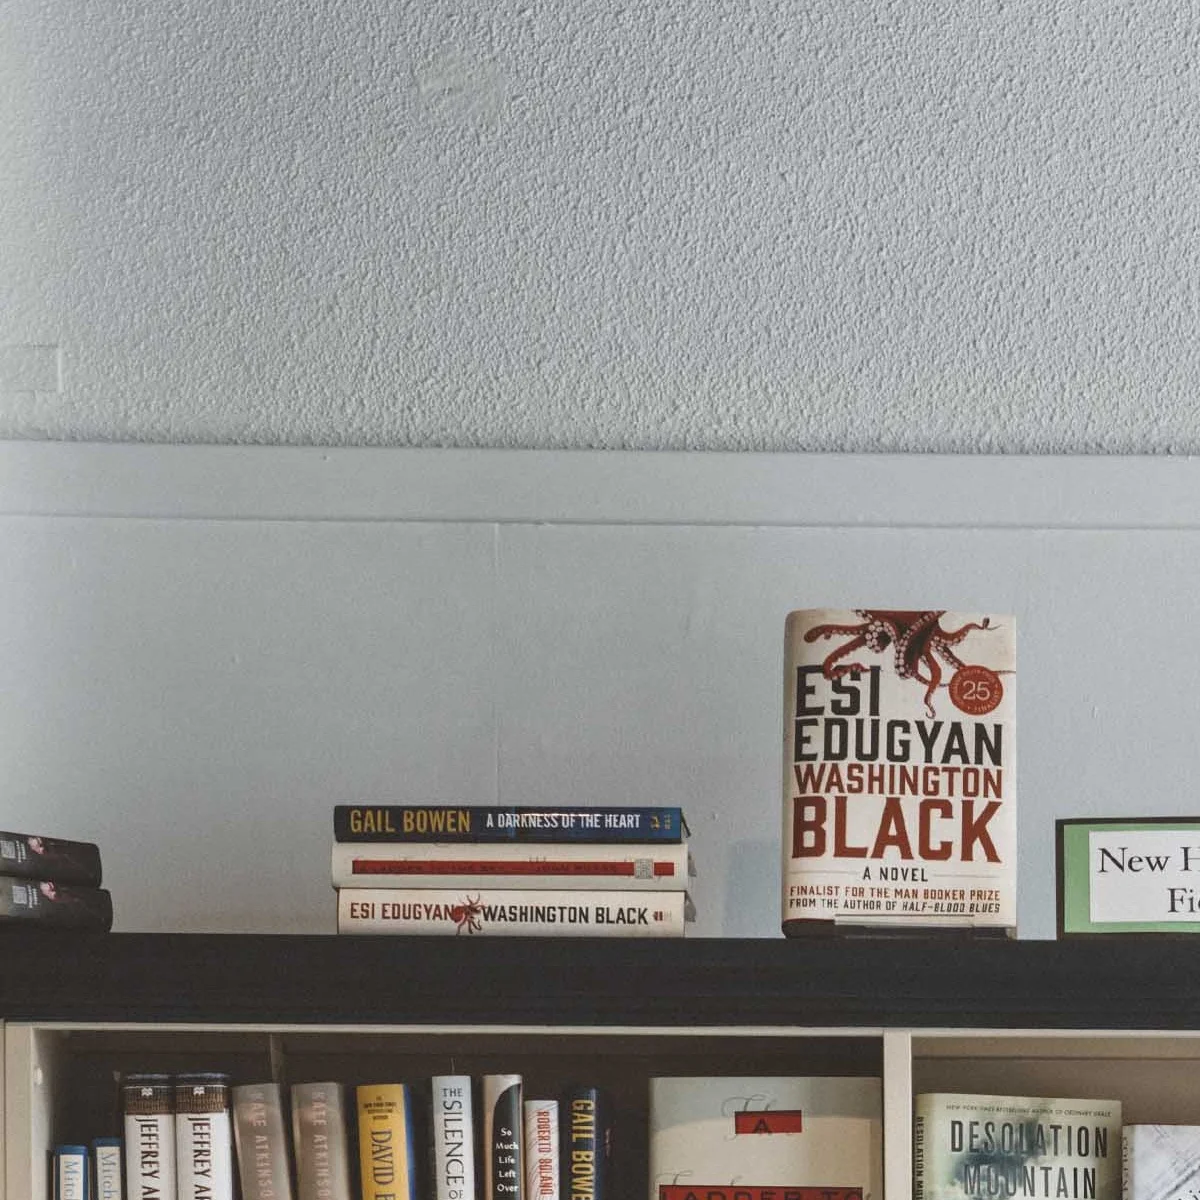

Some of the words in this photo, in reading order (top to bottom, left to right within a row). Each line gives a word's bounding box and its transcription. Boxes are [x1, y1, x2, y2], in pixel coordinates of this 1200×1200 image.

[796, 665, 879, 717] ESI
[962, 680, 991, 701] 25
[796, 718, 1002, 766] EDUGYAN
[794, 765, 1001, 799] WASHINGTON
[351, 810, 394, 833] GAIL
[404, 810, 471, 832] BOWEN
[486, 814, 494, 827] A
[498, 814, 558, 828] DARKNESS
[562, 814, 576, 828] OF
[581, 814, 601, 828] THE
[604, 814, 641, 828] HEART
[792, 796, 1002, 862] BLACK
[1098, 847, 1169, 874] New
[862, 868, 871, 881] A
[879, 867, 928, 882] NOVEL
[790, 886, 841, 898] FINALIST
[845, 887, 866, 898] FOR
[870, 887, 890, 899] THE
[894, 888, 919, 900] MAN
[923, 889, 966, 900] BOOKER
[969, 889, 1001, 901] PRIZE
[350, 902, 375, 920] ESI
[382, 903, 454, 921] EDUGYAN
[482, 906, 589, 923] WASHINGTON
[596, 907, 649, 925] BLACK
[790, 898, 817, 909] FROM
[820, 899, 839, 910] THE
[841, 900, 881, 911] AUTHOR
[885, 901, 896, 911] OF
[901, 902, 966, 913] HALF-BLOOD
[969, 902, 1001, 914] BLUES
[442, 1087, 463, 1098] THE
[501, 1127, 512, 1137] So
[754, 1118, 770, 1133] A
[135, 1117, 160, 1180] JEFFREY
[443, 1101, 465, 1186] SILENCE
[496, 1142, 519, 1151] Much
[951, 1120, 1108, 1158] DESOLATION
[371, 1129, 392, 1187] DAVID
[498, 1155, 515, 1165] Life
[498, 1169, 516, 1179] Left
[963, 1165, 1097, 1200] MOUNTAIN
[449, 1189, 464, 1200] OF
[497, 1183, 519, 1194] Over
